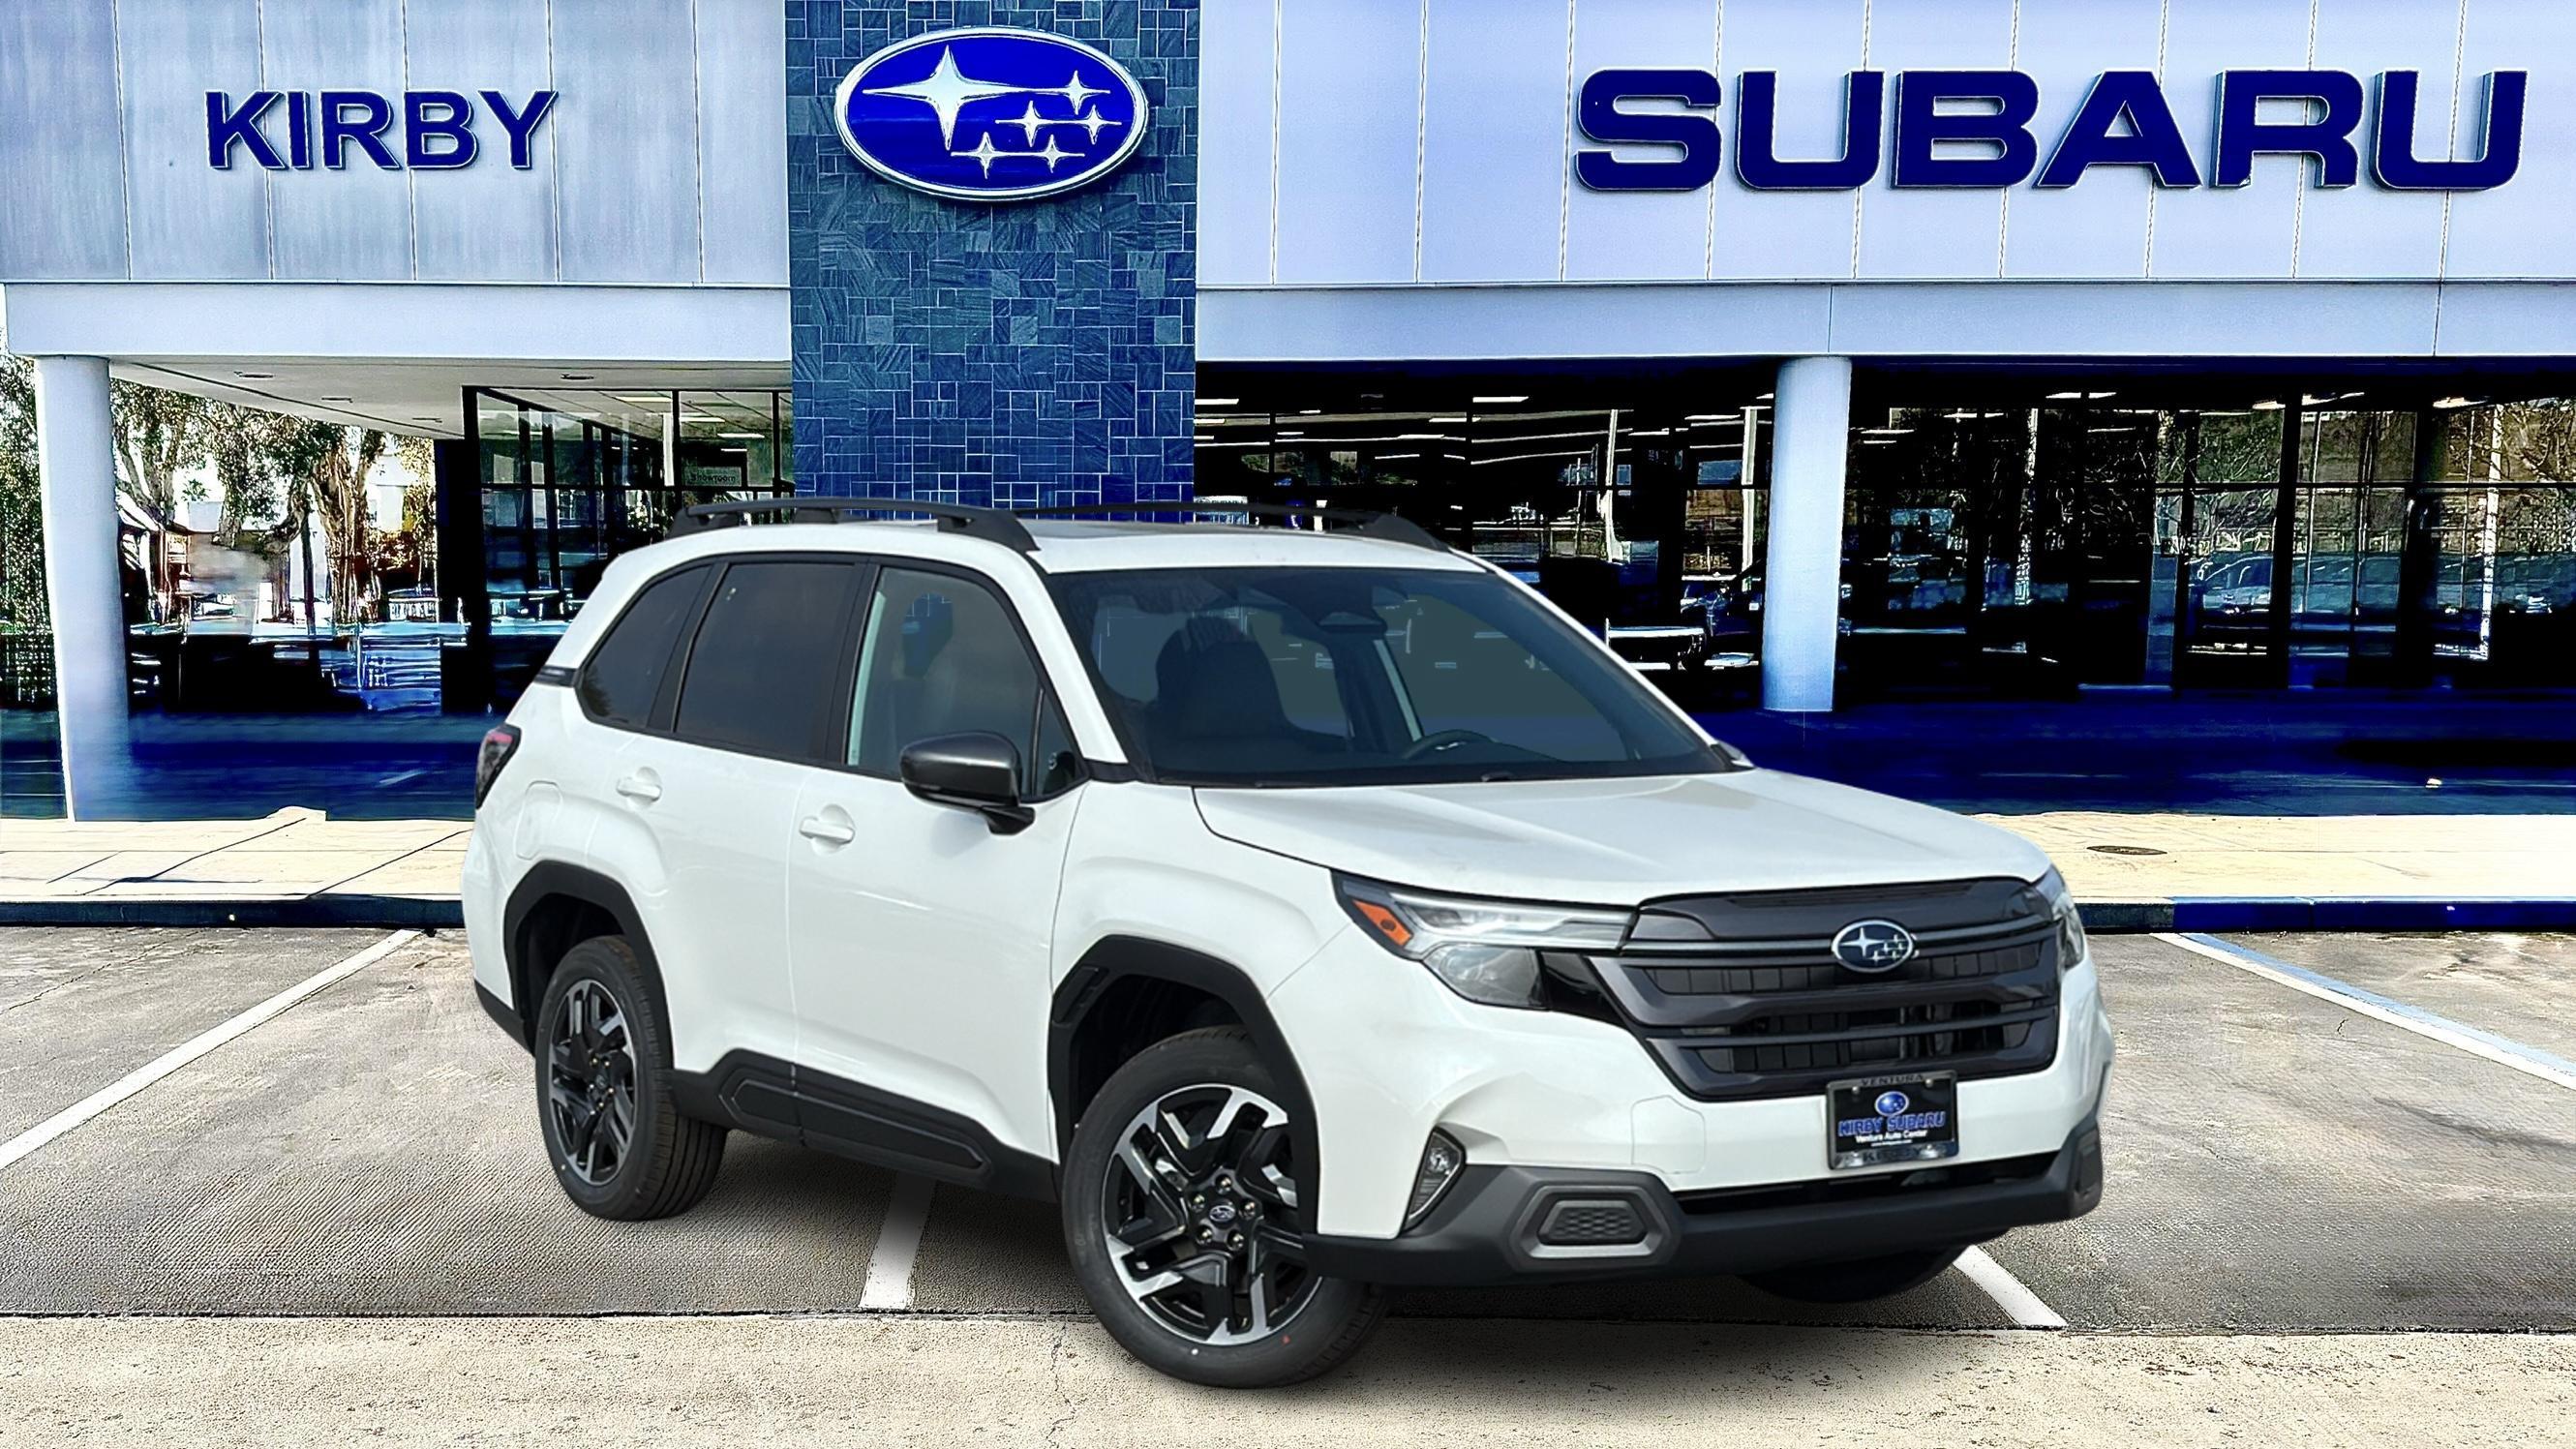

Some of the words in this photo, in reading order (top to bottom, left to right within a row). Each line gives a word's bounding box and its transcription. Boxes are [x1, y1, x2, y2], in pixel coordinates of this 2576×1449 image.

[205, 90, 559, 170] KIRBY
[1574, 68, 2529, 191] SUBARU
[1862, 1073, 1924, 1086] VENTURA
[1838, 1117, 1884, 1136] KIRBY
[1887, 1111, 1946, 1132] SUBARU
[1884, 1132, 1902, 1140] Auto
[1903, 1130, 1928, 1139] Center
